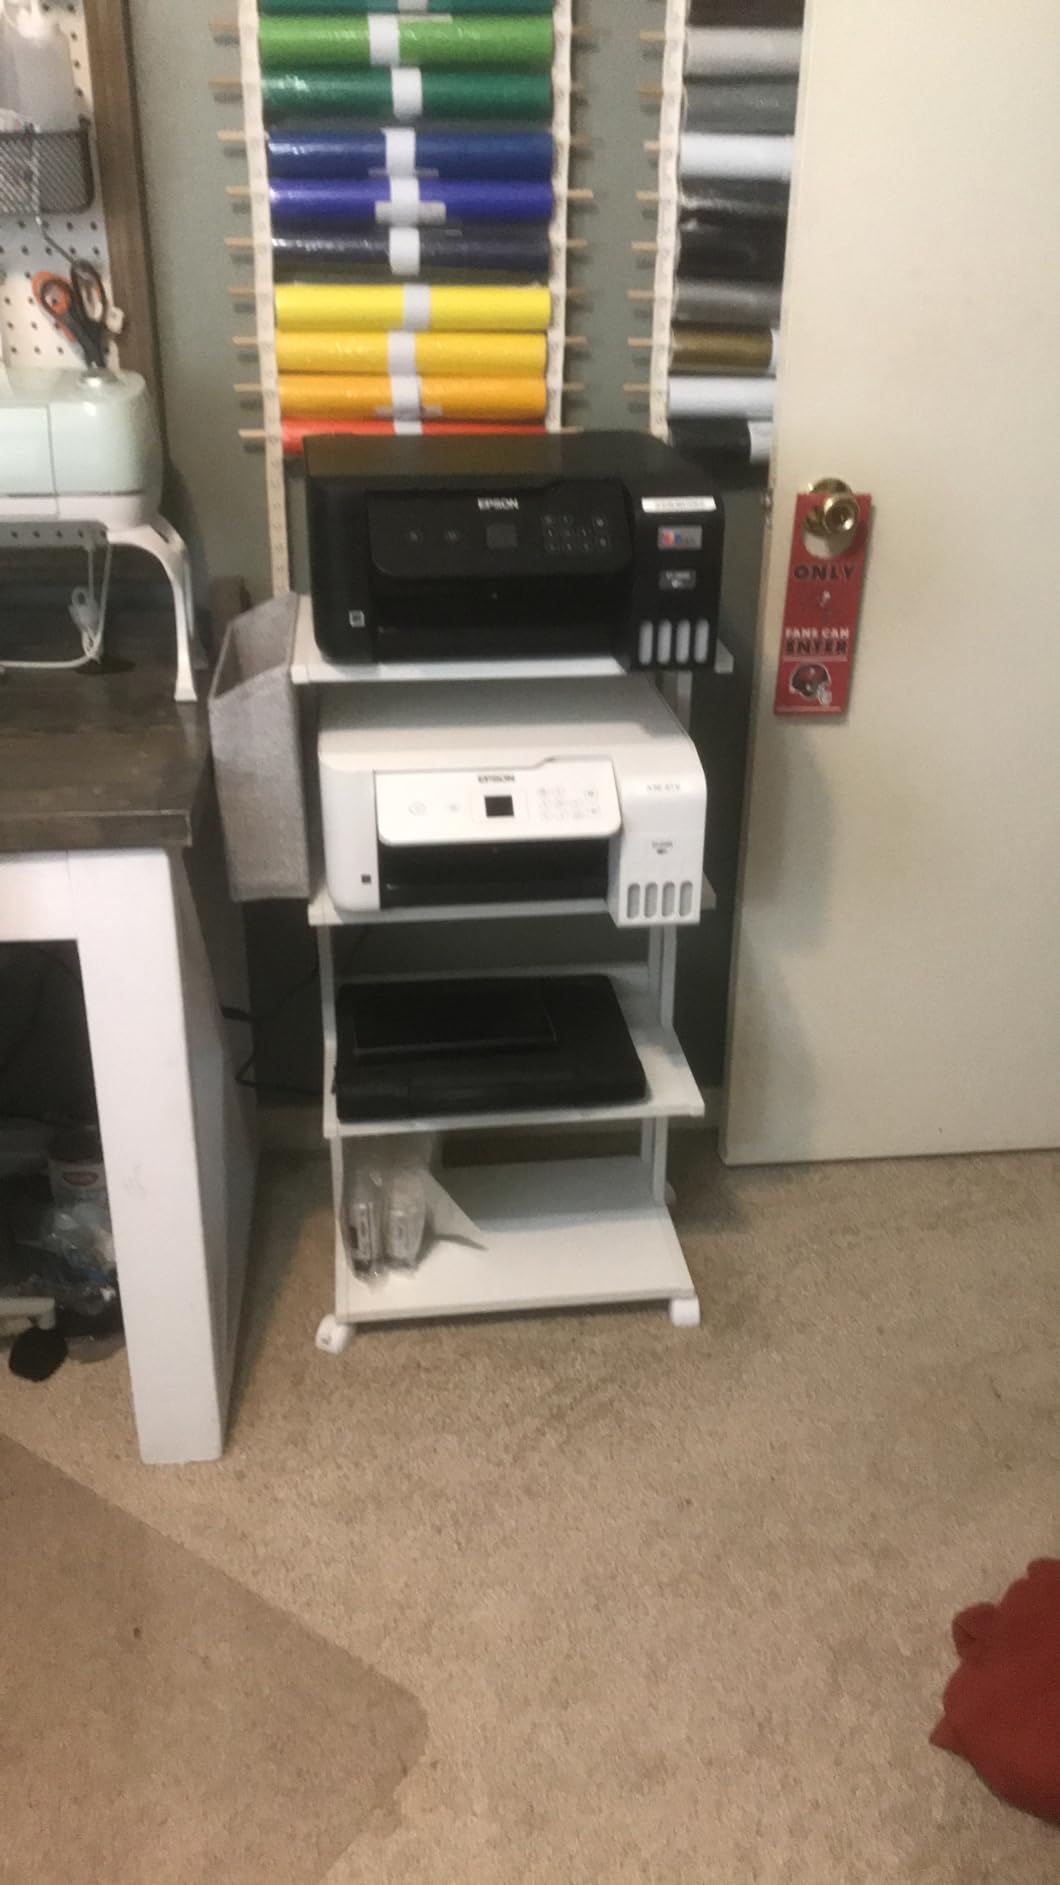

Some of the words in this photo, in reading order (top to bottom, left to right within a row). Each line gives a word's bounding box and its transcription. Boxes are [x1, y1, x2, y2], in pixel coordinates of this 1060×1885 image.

[478, 498, 519, 510] EPSON
[795, 565, 854, 581] ONLY
[785, 628, 818, 639] FANS
[821, 628, 850, 640] CAN
[785, 640, 847, 655] ENTER
